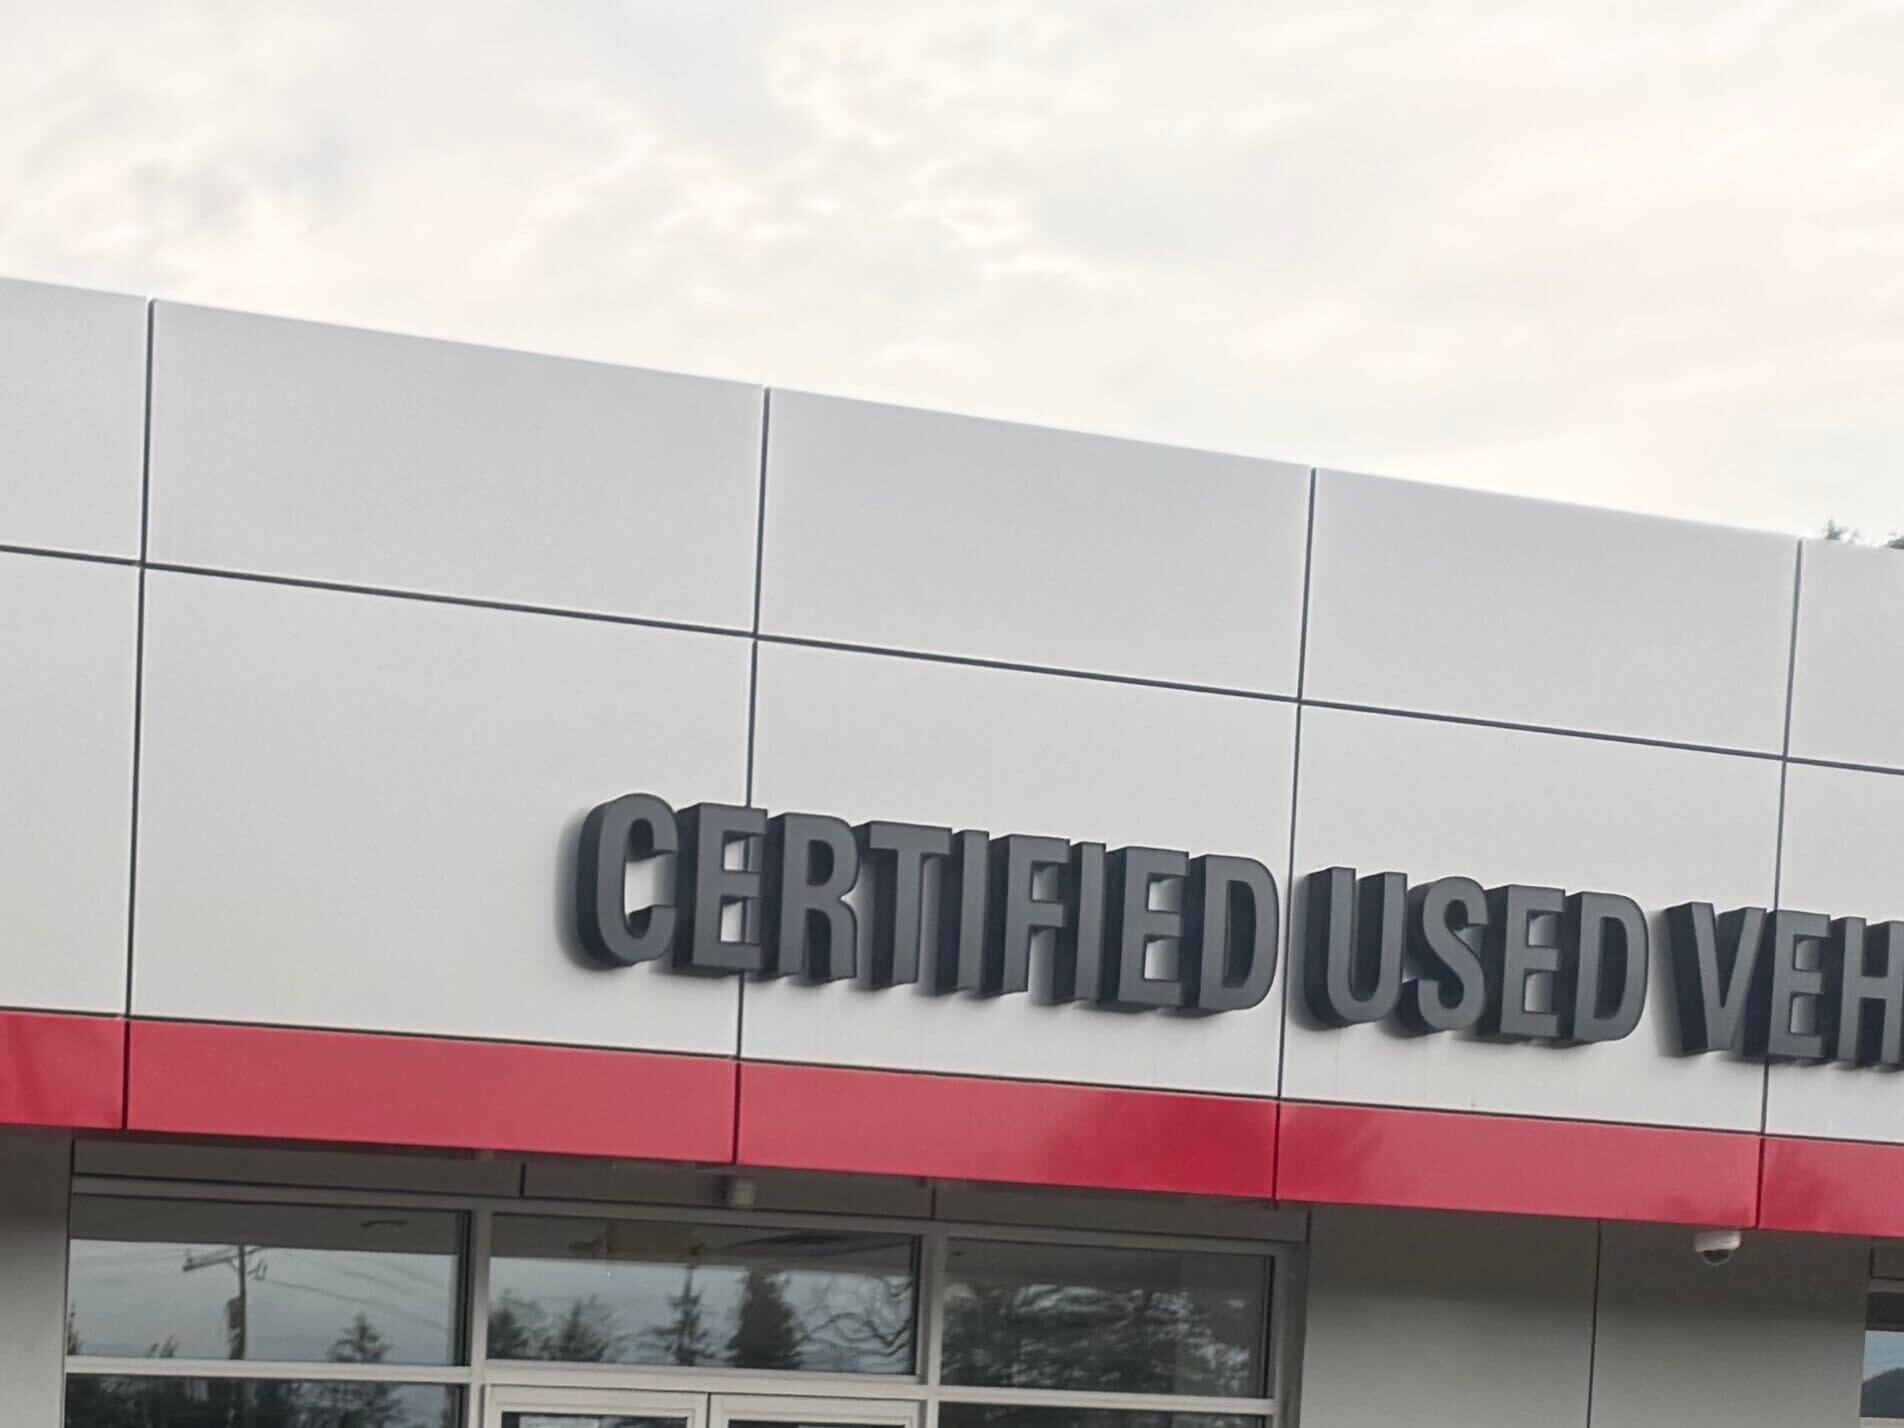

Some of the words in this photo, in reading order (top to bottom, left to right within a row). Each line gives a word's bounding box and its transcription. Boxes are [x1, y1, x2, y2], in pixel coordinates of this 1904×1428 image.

[577, 792, 1280, 1010] CERTIFIED
[1303, 866, 1649, 1044] USED
[1666, 901, 1904, 1066] VEH
